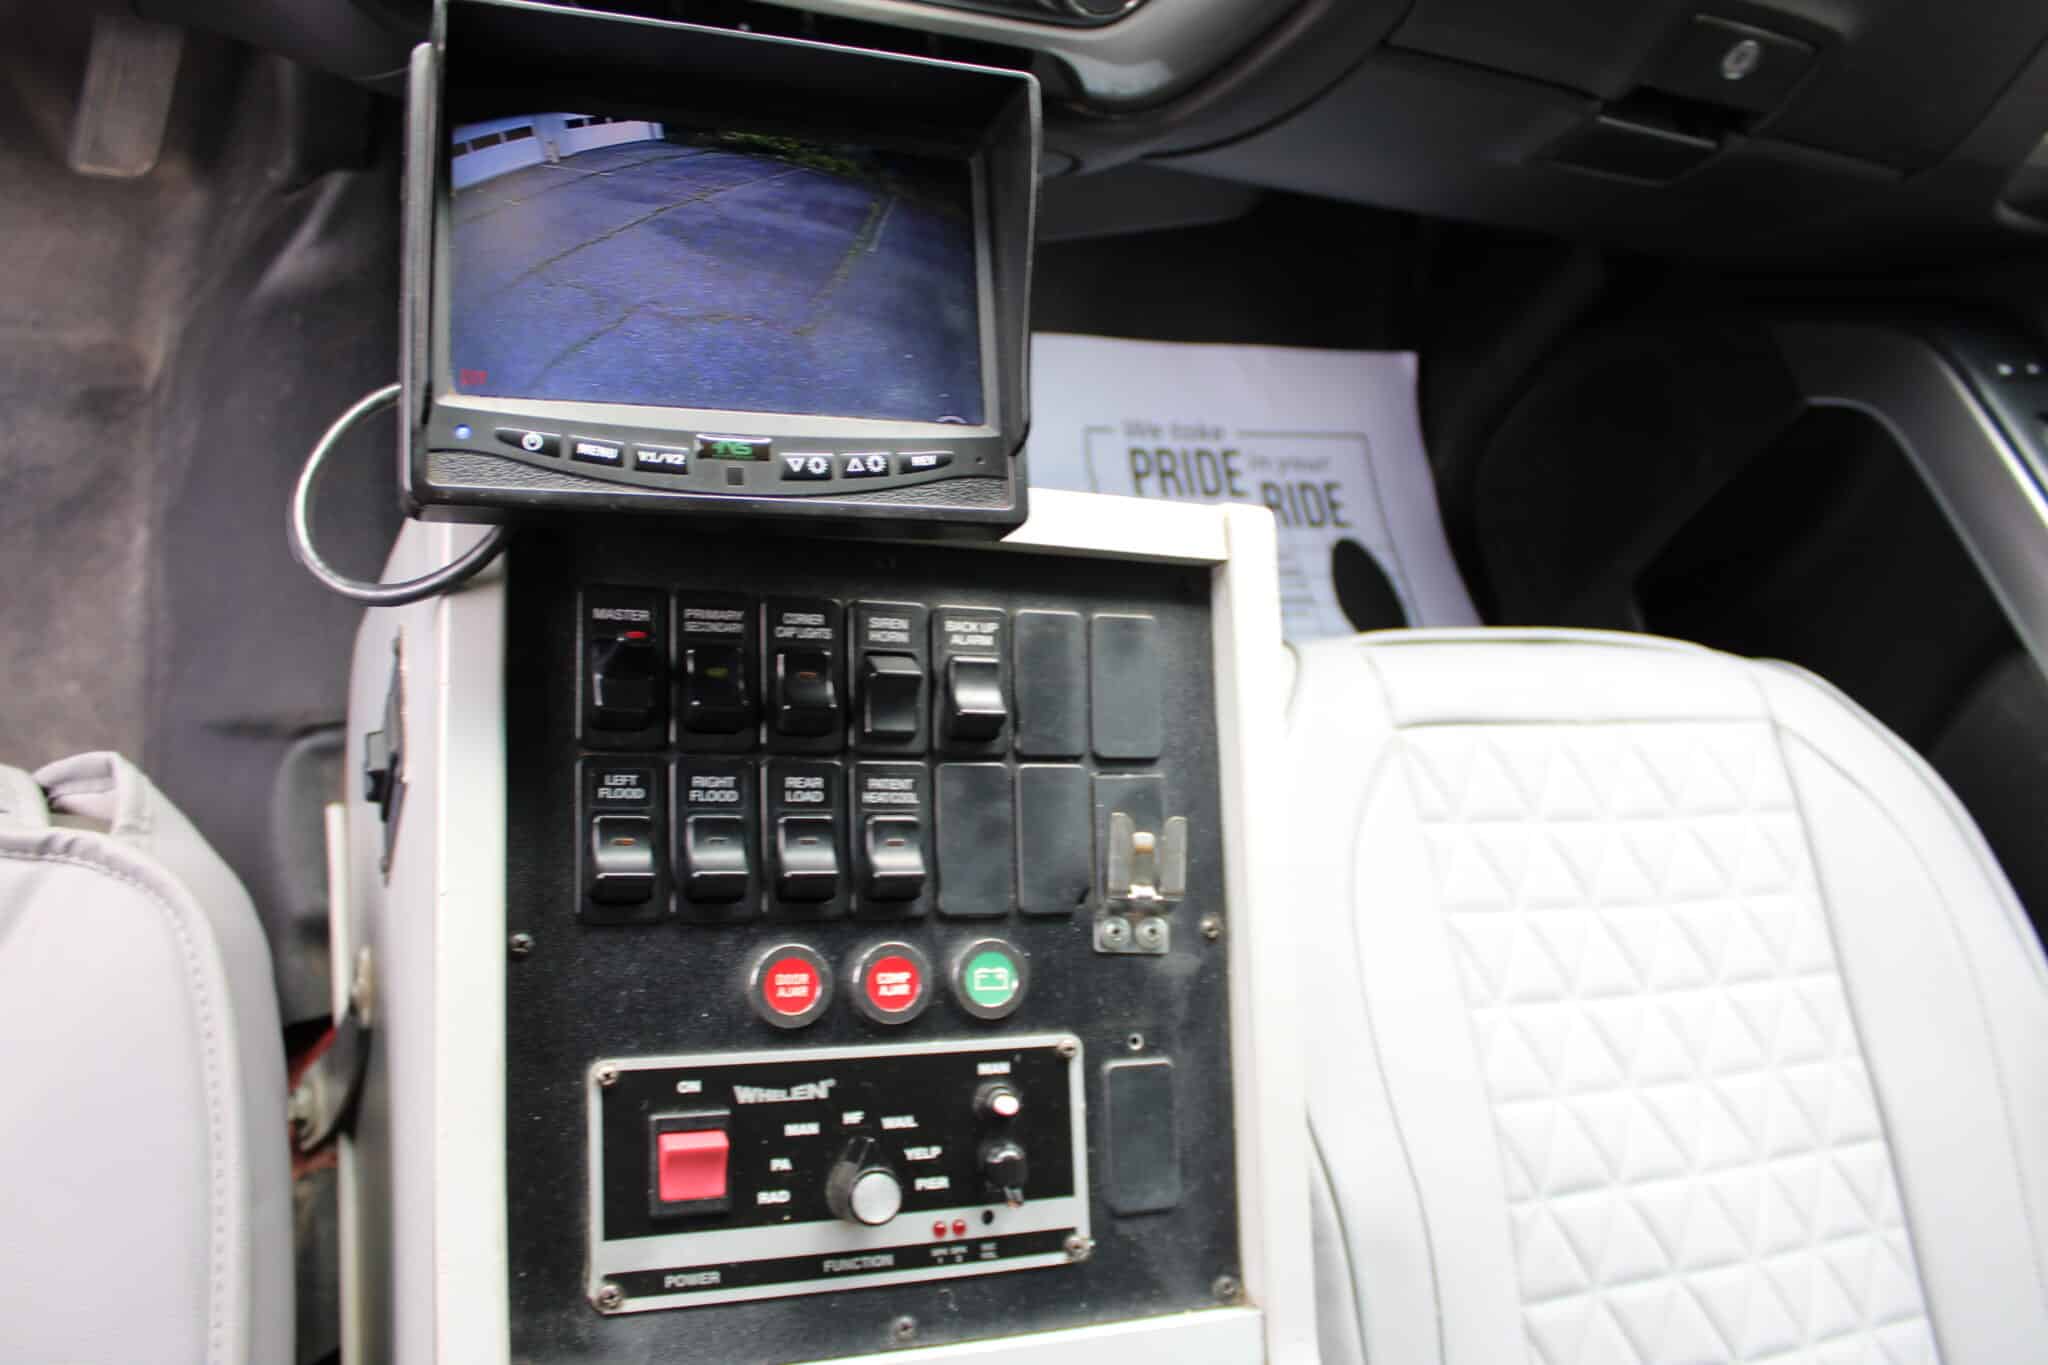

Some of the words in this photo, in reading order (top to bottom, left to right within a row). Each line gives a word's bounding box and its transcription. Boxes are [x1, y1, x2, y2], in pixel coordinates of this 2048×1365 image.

[1129, 447, 1250, 498] PRIDE
[1259, 481, 1351, 529] RIDE
[592, 608, 651, 622] MASTER
[604, 774, 638, 786] LEFT
[691, 775, 737, 788] RIGHT
[784, 776, 825, 789] REAR
[597, 787, 646, 800] FLOOD
[688, 789, 739, 803] FLOOD
[784, 790, 825, 803] LOAD
[733, 1080, 830, 1104] WHELEN
[823, 1253, 895, 1274] FUNCTION
[663, 1271, 721, 1288] POWER
